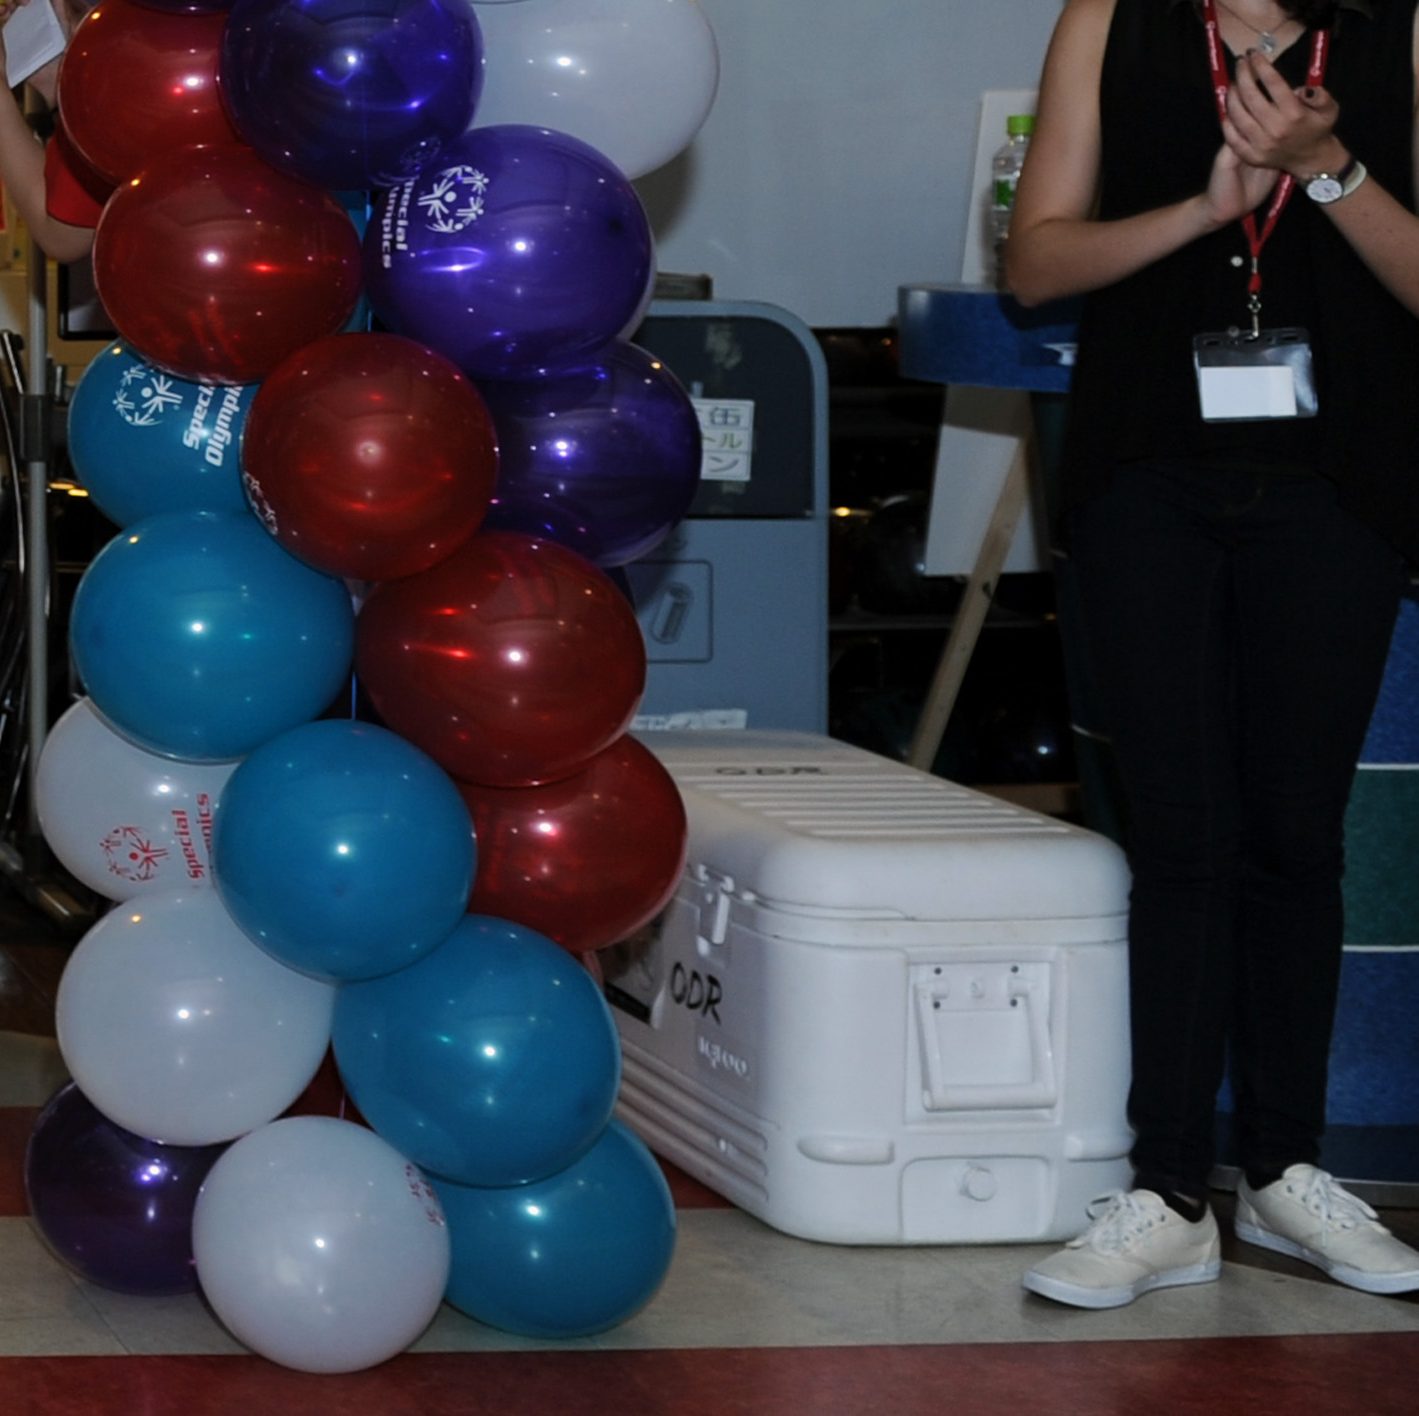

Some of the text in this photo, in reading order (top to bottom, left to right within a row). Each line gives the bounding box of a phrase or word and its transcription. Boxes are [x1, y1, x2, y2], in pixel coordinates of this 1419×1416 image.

[183, 385, 216, 450] Speci
[205, 386, 244, 467] Olympi
[171, 809, 205, 878] Special
[671, 961, 723, 1026] ODR
